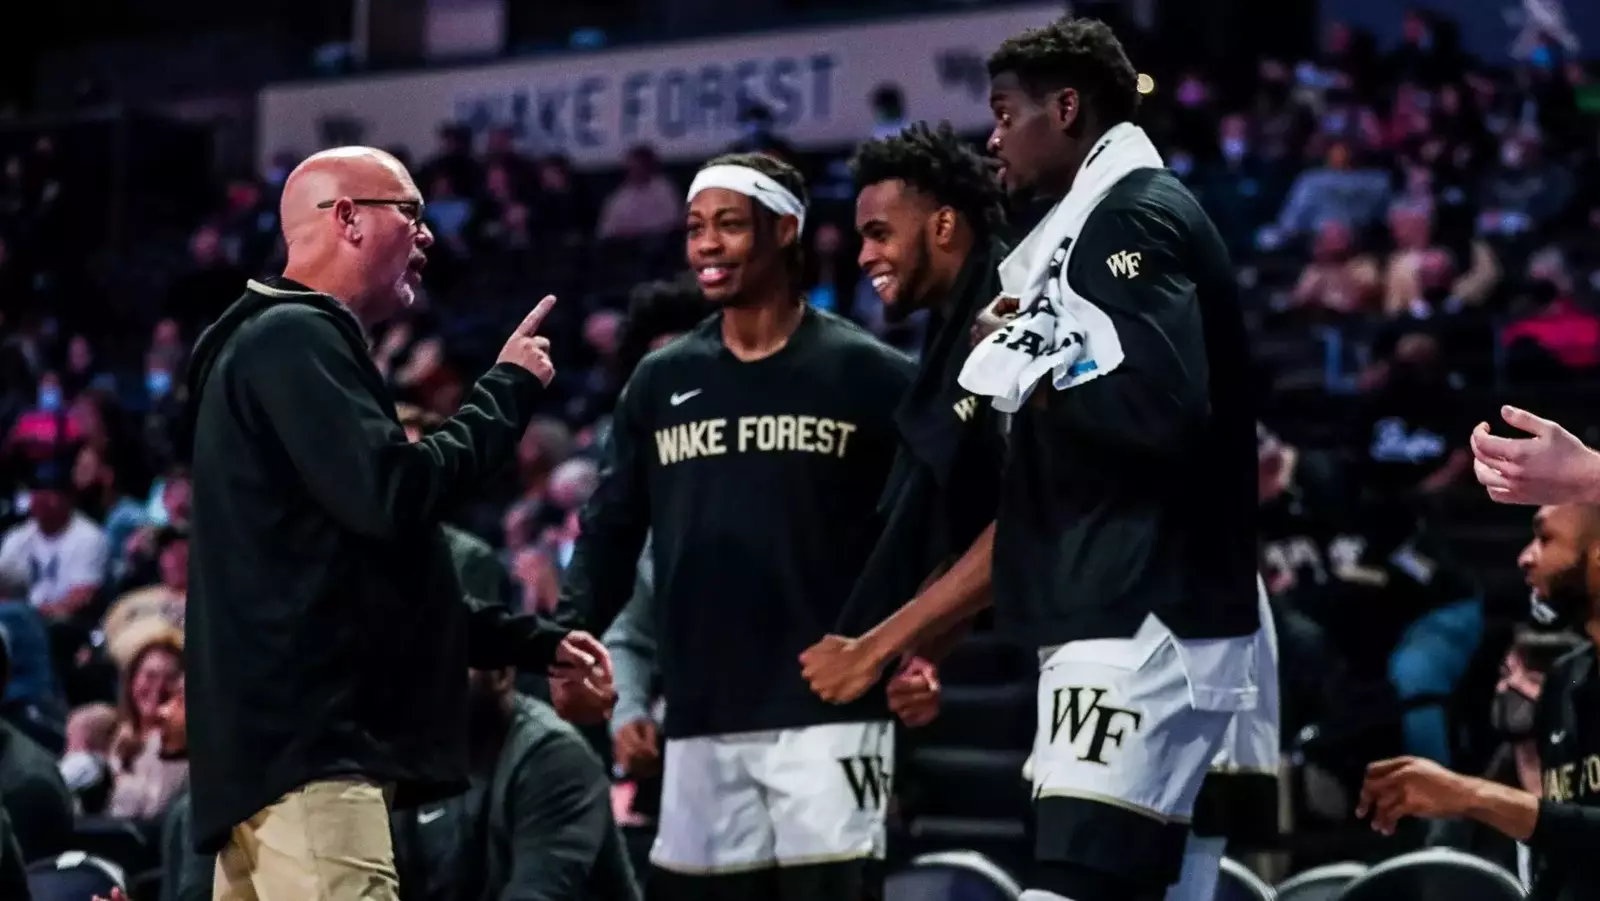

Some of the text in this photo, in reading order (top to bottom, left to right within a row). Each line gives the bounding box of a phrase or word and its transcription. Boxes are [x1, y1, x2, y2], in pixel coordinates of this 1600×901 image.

[454, 76, 606, 152] WAKE
[618, 52, 839, 138] FOREST
[1106, 250, 1142, 279] WF
[953, 395, 979, 422] W
[655, 415, 857, 466] WAKE FOREST
[1050, 687, 1142, 766] WF
